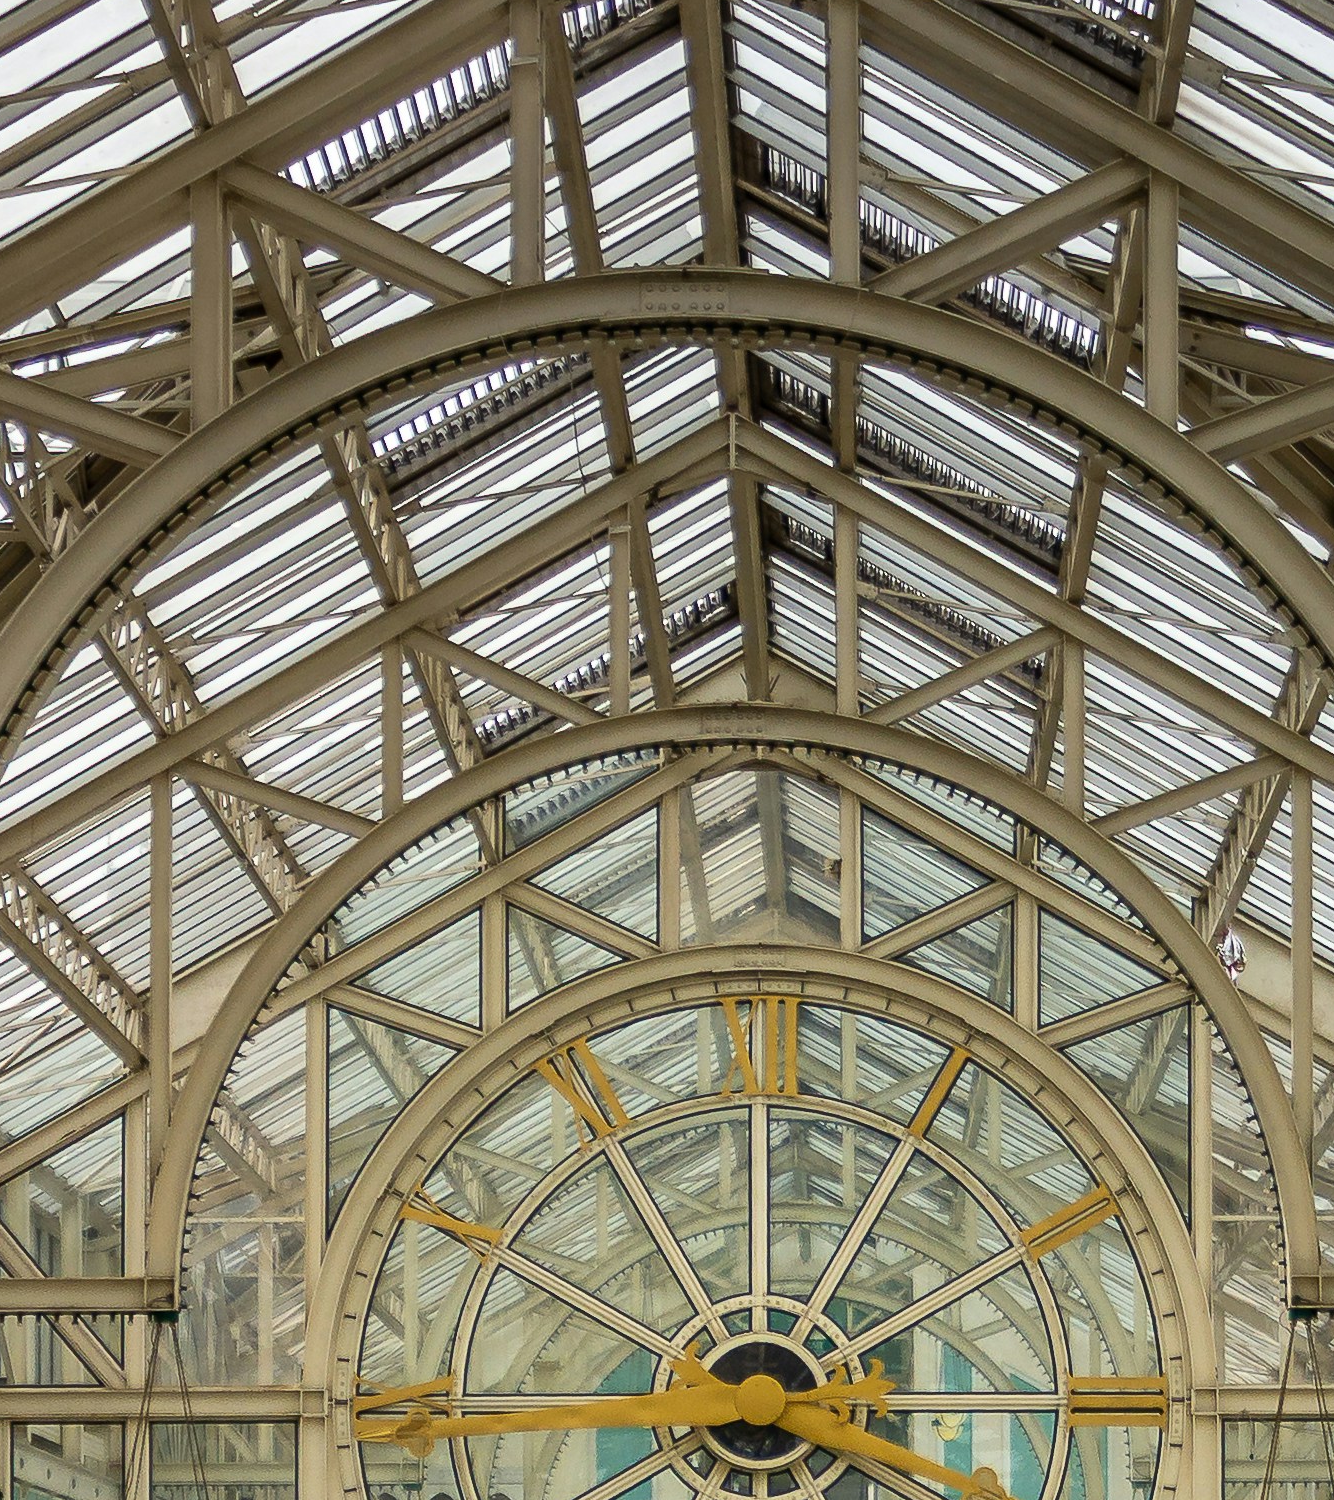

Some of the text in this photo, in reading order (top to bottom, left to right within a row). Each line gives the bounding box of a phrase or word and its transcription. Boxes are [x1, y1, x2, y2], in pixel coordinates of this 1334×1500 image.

[721, 997, 799, 1096] XII
[533, 1037, 630, 1155] XI
[1020, 1182, 1120, 1263] II
[1067, 1376, 1166, 1428] III
